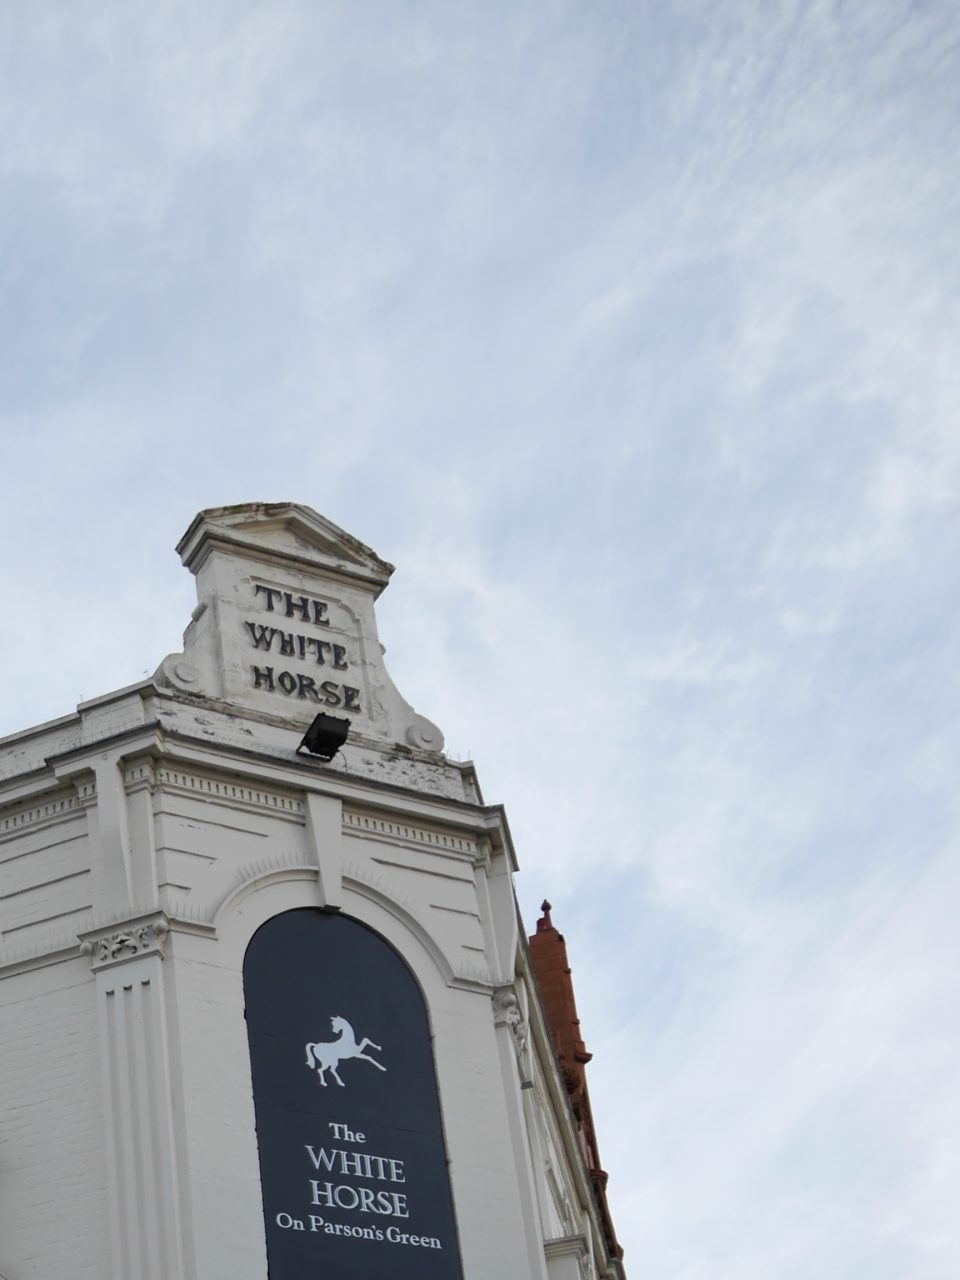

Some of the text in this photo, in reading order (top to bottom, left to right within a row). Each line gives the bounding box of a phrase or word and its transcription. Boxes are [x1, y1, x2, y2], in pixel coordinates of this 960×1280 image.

[255, 584, 330, 626] THE
[244, 620, 349, 671] WHITE
[250, 665, 362, 714] HORSE
[328, 1122, 367, 1144] The
[304, 1144, 407, 1184] WHITE
[309, 1179, 411, 1219] HORSE
[275, 1212, 443, 1250] On Parson's Green
